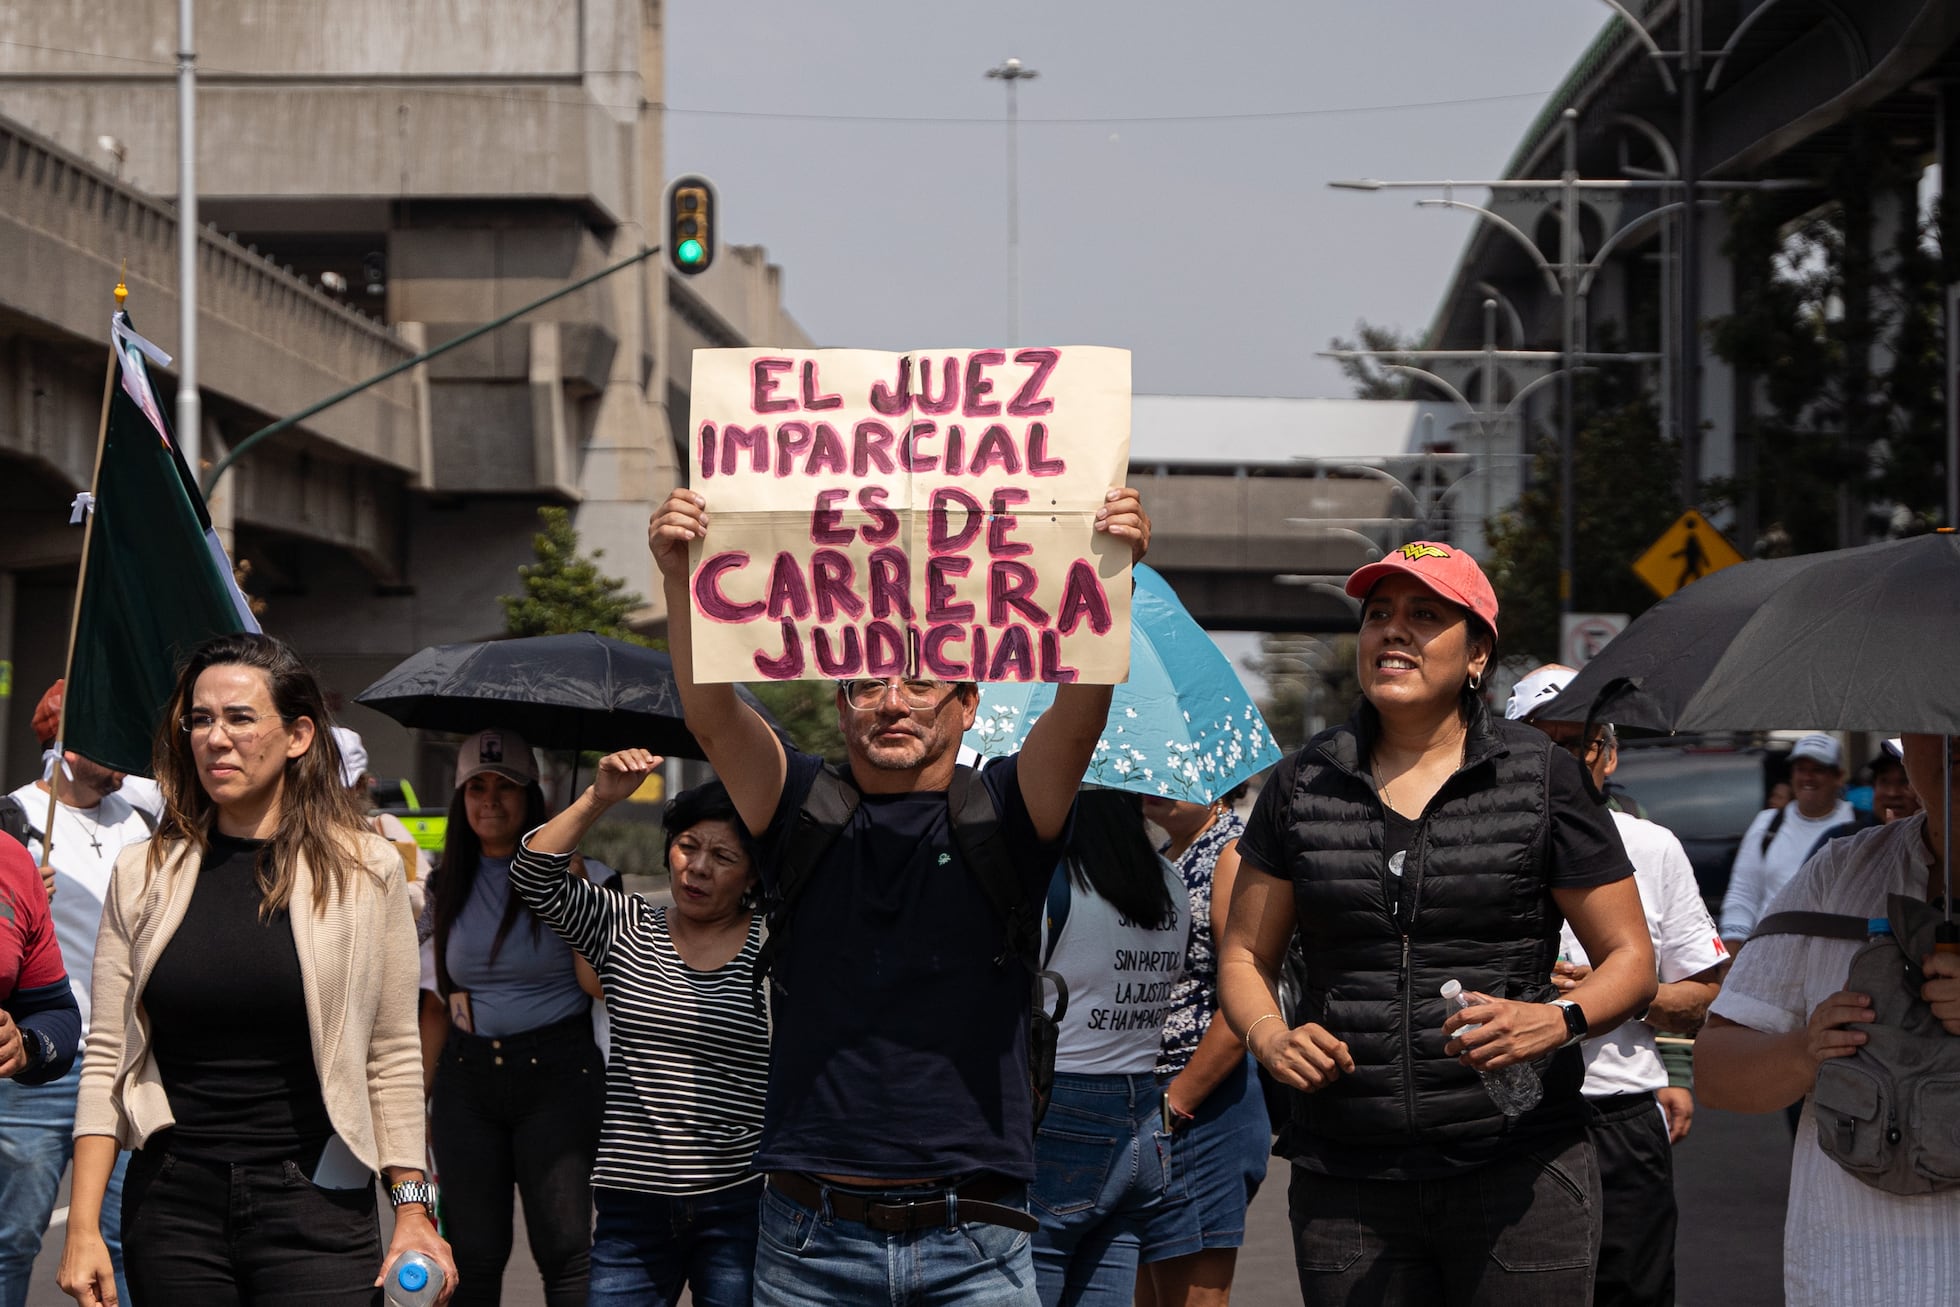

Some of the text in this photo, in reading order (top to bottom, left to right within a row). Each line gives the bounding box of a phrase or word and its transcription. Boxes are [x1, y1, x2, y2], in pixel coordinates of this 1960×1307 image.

[750, 348, 1062, 417] EL JUEZ
[699, 419, 1067, 480] IMPARCIAL
[810, 485, 1034, 557] ES DE
[692, 545, 1112, 636] CARRERA
[754, 615, 1080, 683] JUDICIAL
[1114, 950, 1138, 972] SIN
[1088, 1009, 1110, 1030] SE
[1109, 1009, 1128, 1030] HA
[1115, 983, 1132, 1004] LA
